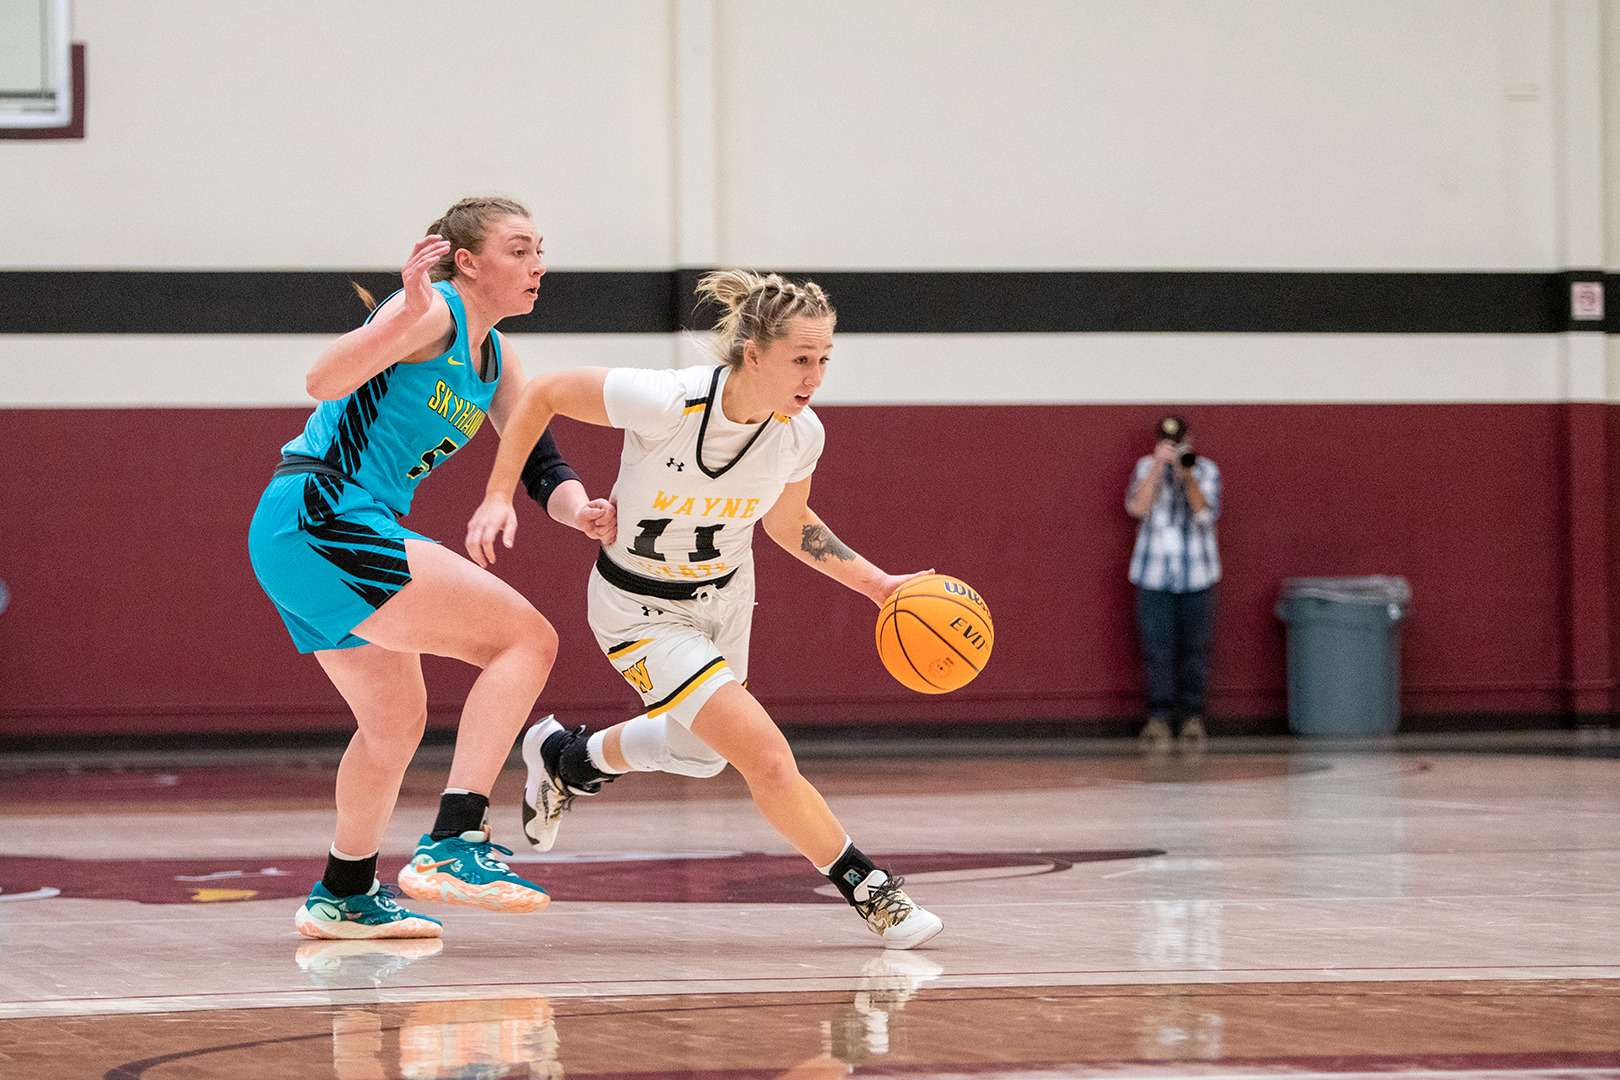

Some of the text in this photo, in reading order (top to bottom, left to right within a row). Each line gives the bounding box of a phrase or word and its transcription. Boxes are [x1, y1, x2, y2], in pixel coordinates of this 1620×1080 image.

[406, 436, 459, 479] 5
[652, 490, 760, 519] WAYNE
[626, 518, 726, 562] 11
[621, 656, 654, 694] W
